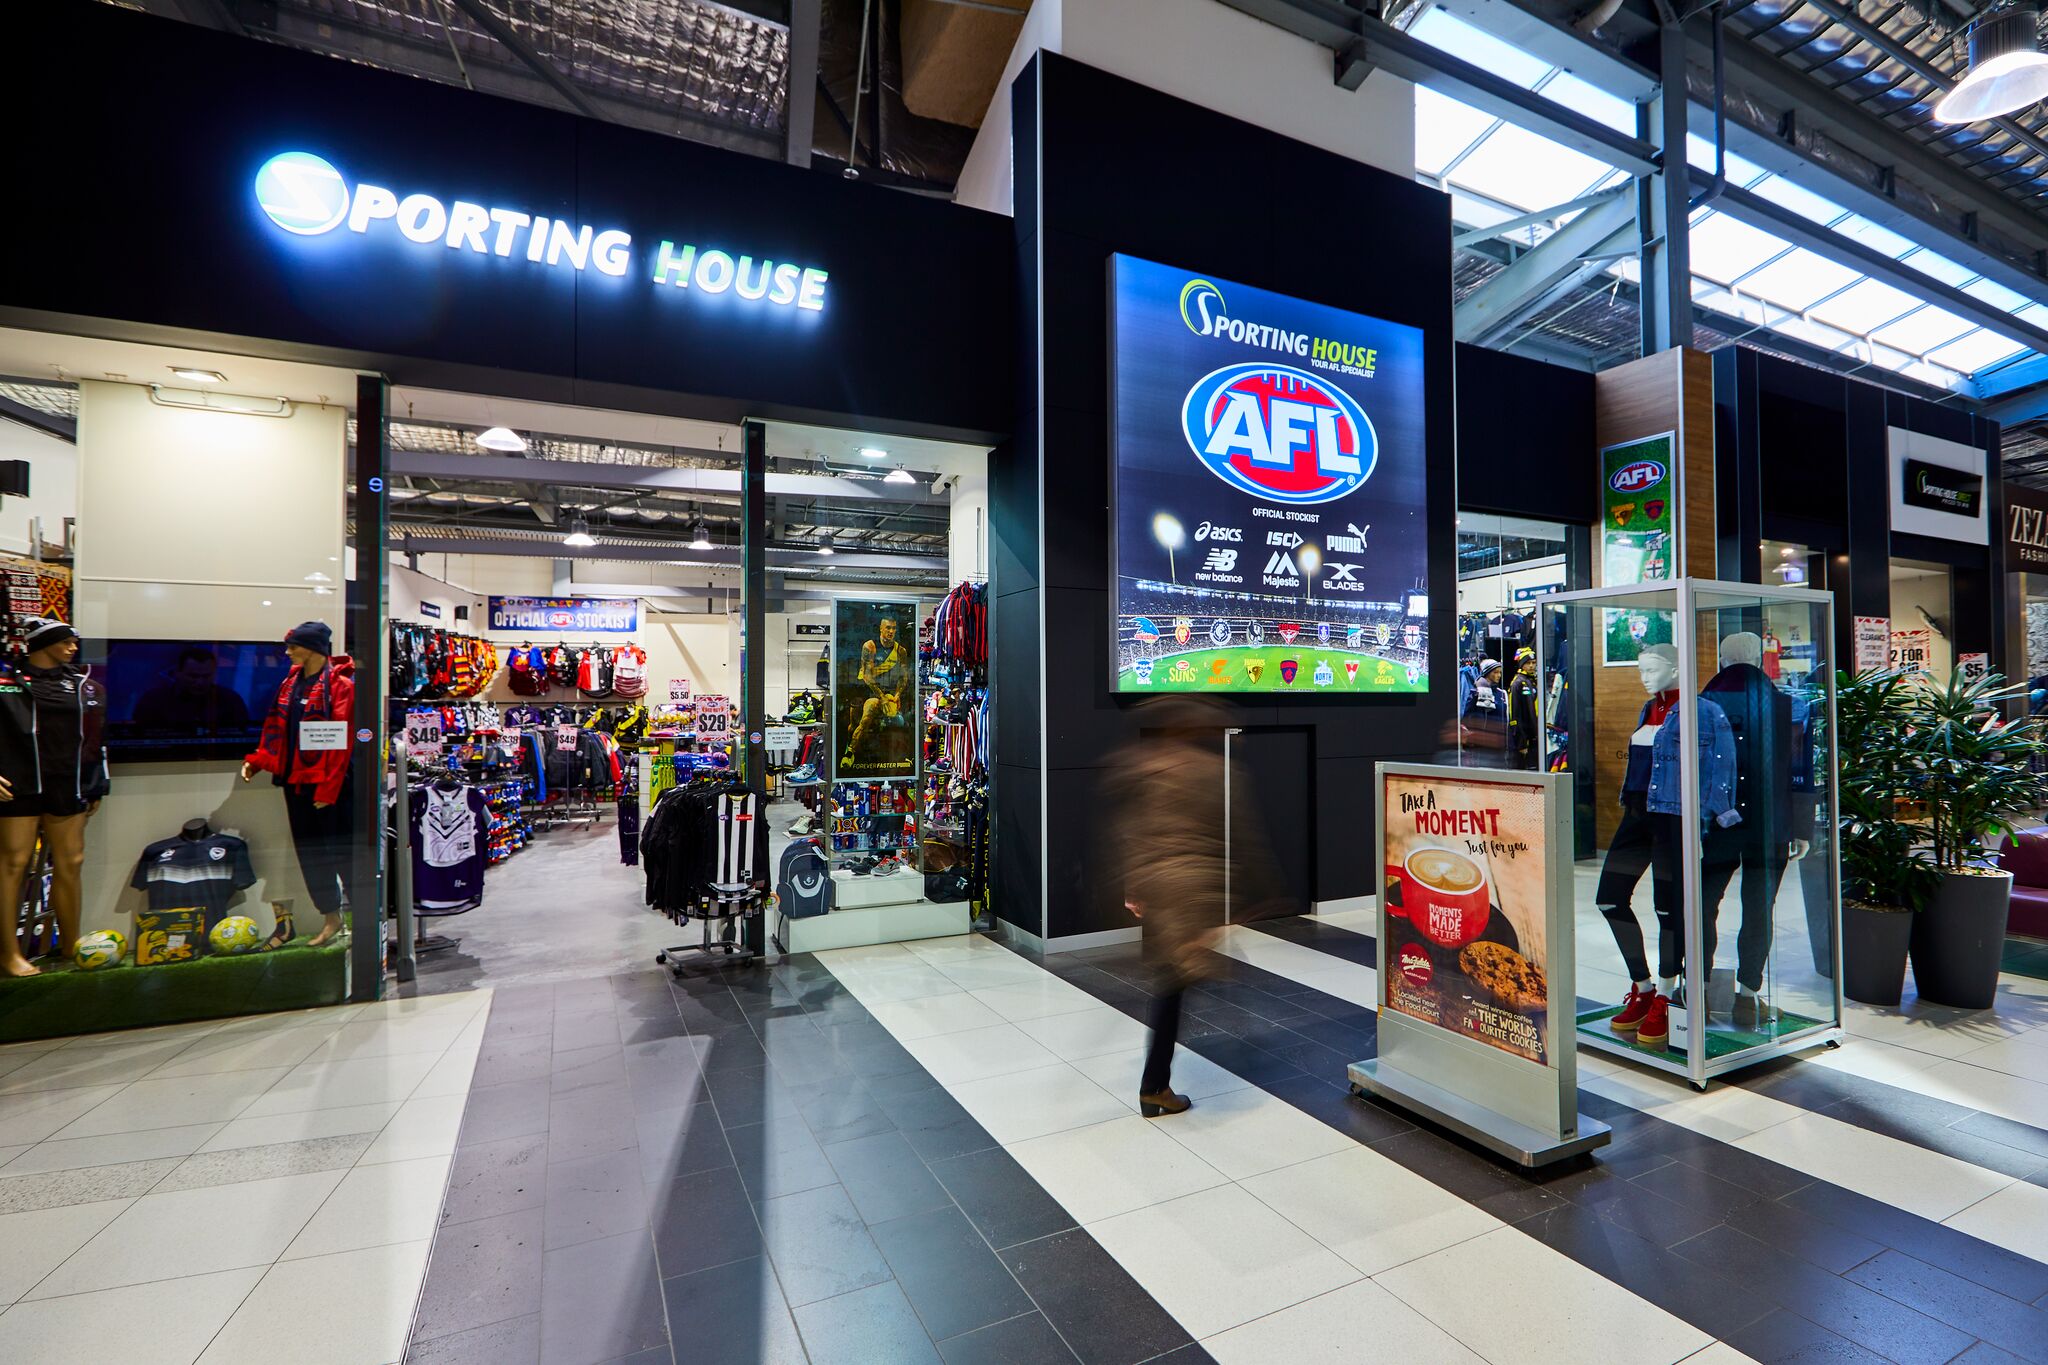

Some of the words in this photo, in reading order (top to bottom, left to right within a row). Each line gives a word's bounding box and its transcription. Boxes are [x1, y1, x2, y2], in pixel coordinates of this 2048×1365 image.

[255, 151, 633, 276] SPORTING
[653, 240, 829, 311] HOUSE
[1196, 290, 1310, 357] SPORTING
[1311, 337, 1378, 371] HOUSE
[1311, 358, 1328, 370] YOUR
[1328, 361, 1341, 373] AFL
[1341, 364, 1375, 379] SPECIALIST
[1204, 389, 1363, 475] AFL
[1614, 466, 1661, 489] AFL
[1252, 507, 1285, 520] OFFICIAL
[1285, 510, 1320, 523] STOCKIST
[2009, 504, 2048, 549] ZEZ
[1326, 534, 1364, 554] PUMA
[1195, 572, 1212, 581] new
[1212, 572, 1243, 583] balance
[1263, 574, 1300, 589] Majestic
[1323, 580, 1365, 592] BLADES
[494, 611, 548, 627] OFFICIAL
[550, 615, 574, 625] AFL
[577, 613, 631, 629] STOCKIST
[1890, 649, 1899, 662] 2
[1901, 648, 1924, 662] FOR
[1169, 668, 1196, 682] SUNS
[1315, 672, 1333, 682] NORTH
[1965, 663, 1983, 678] $5
[670, 691, 689, 700] $5.50
[699, 713, 726, 733] $29
[1400, 792, 1424, 813] TAKE
[1427, 790, 1436, 810] A
[1415, 809, 1500, 836] MOMENT
[1464, 839, 1489, 856] Just
[1490, 840, 1505, 859] for
[1507, 843, 1529, 859] you
[1429, 903, 1462, 919] MOMENTS
[1430, 912, 1462, 932] MADE
[1430, 926, 1461, 940] BETTER
[1397, 989, 1421, 1003] Located
[1421, 999, 1437, 1008] near
[1404, 1000, 1421, 1011] Food
[1421, 1006, 1440, 1018] Court
[1471, 999, 1490, 1010] Award
[1490, 1006, 1513, 1019] winning
[1513, 1014, 1533, 1025] coffee
[1478, 1009, 1498, 1027] THE
[1499, 1015, 1538, 1040] WORLD'S
[1509, 1032, 1543, 1054] COOKIES
